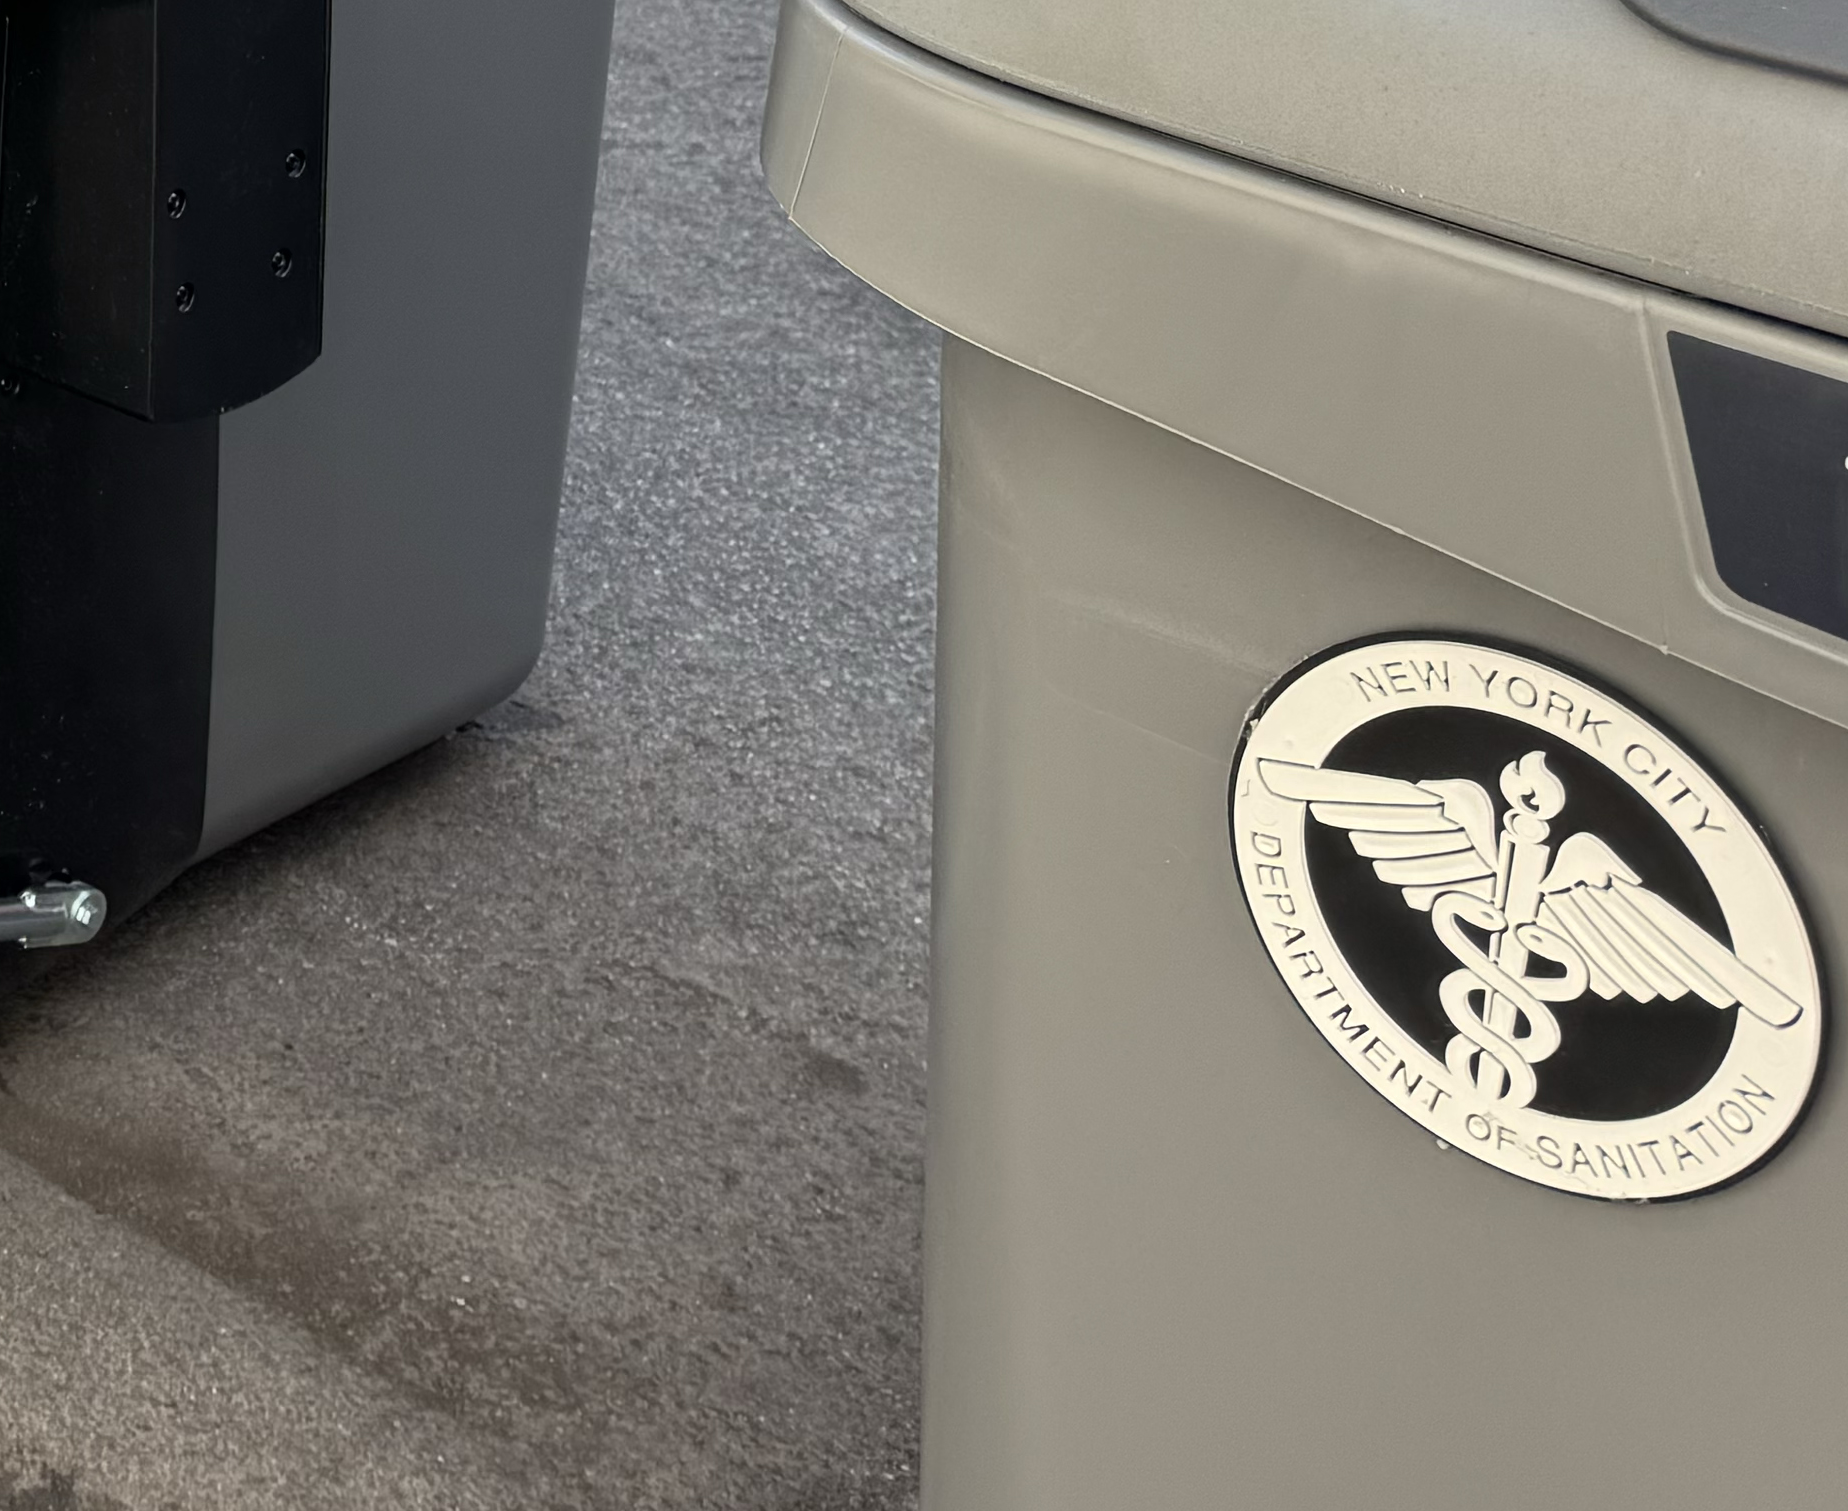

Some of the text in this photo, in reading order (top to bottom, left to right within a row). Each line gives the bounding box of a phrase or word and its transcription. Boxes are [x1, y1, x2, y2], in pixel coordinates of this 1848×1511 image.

[1350, 660, 1728, 837] NEW YORK CITY
[1249, 830, 1777, 1180] DEPARTMENT OF SANITATION
